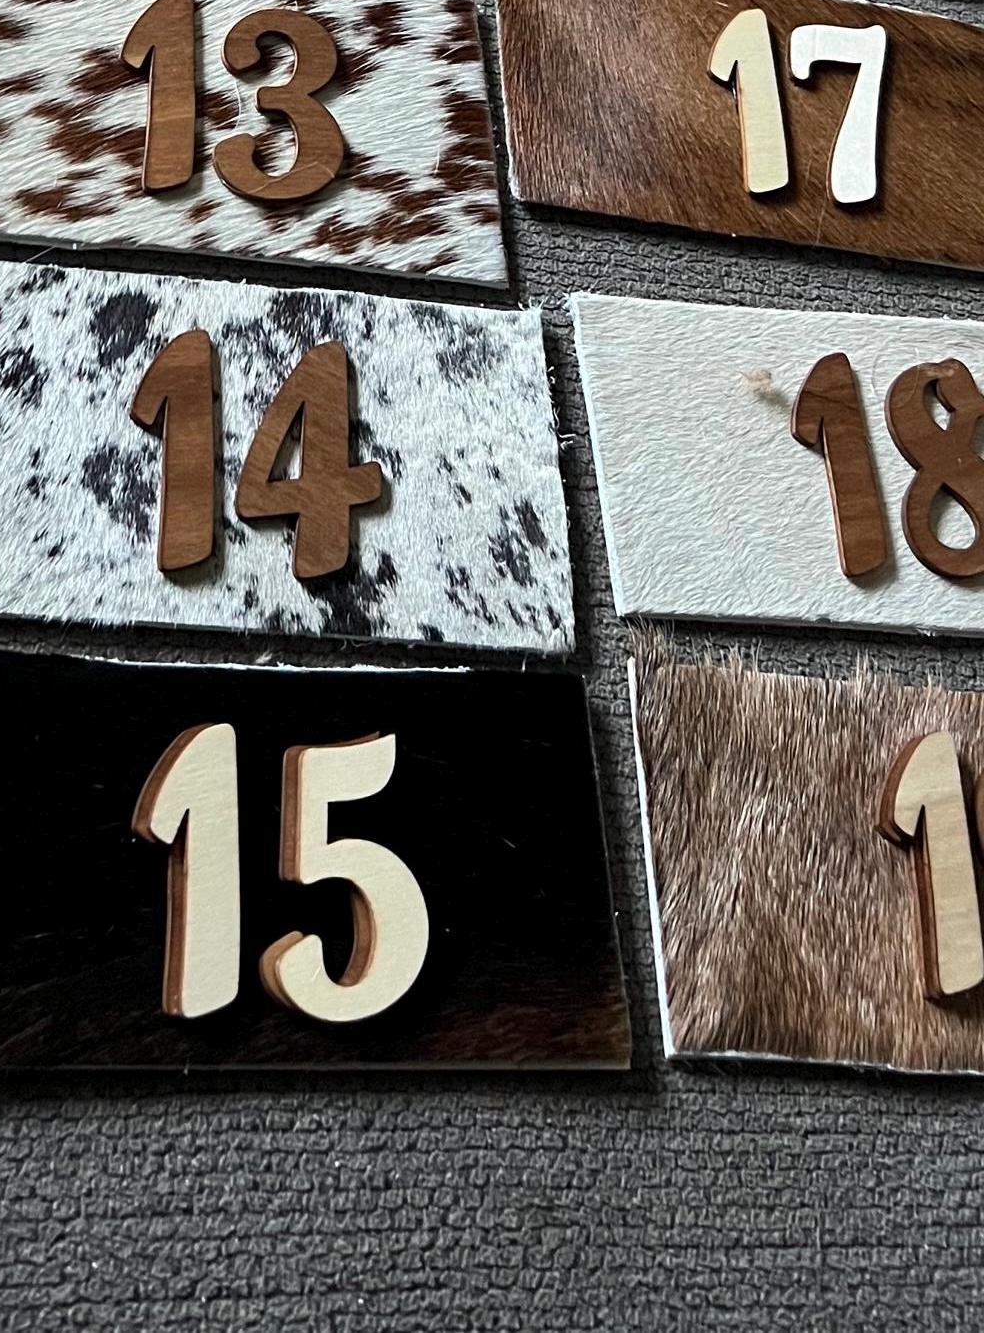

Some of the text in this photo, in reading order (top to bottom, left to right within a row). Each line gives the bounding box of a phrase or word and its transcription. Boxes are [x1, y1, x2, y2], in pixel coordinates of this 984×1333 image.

[708, 8, 888, 204] 17
[130, 332, 384, 581] 14
[791, 352, 984, 579] 18
[131, 722, 430, 1023] 15
[876, 730, 984, 1000] 1
